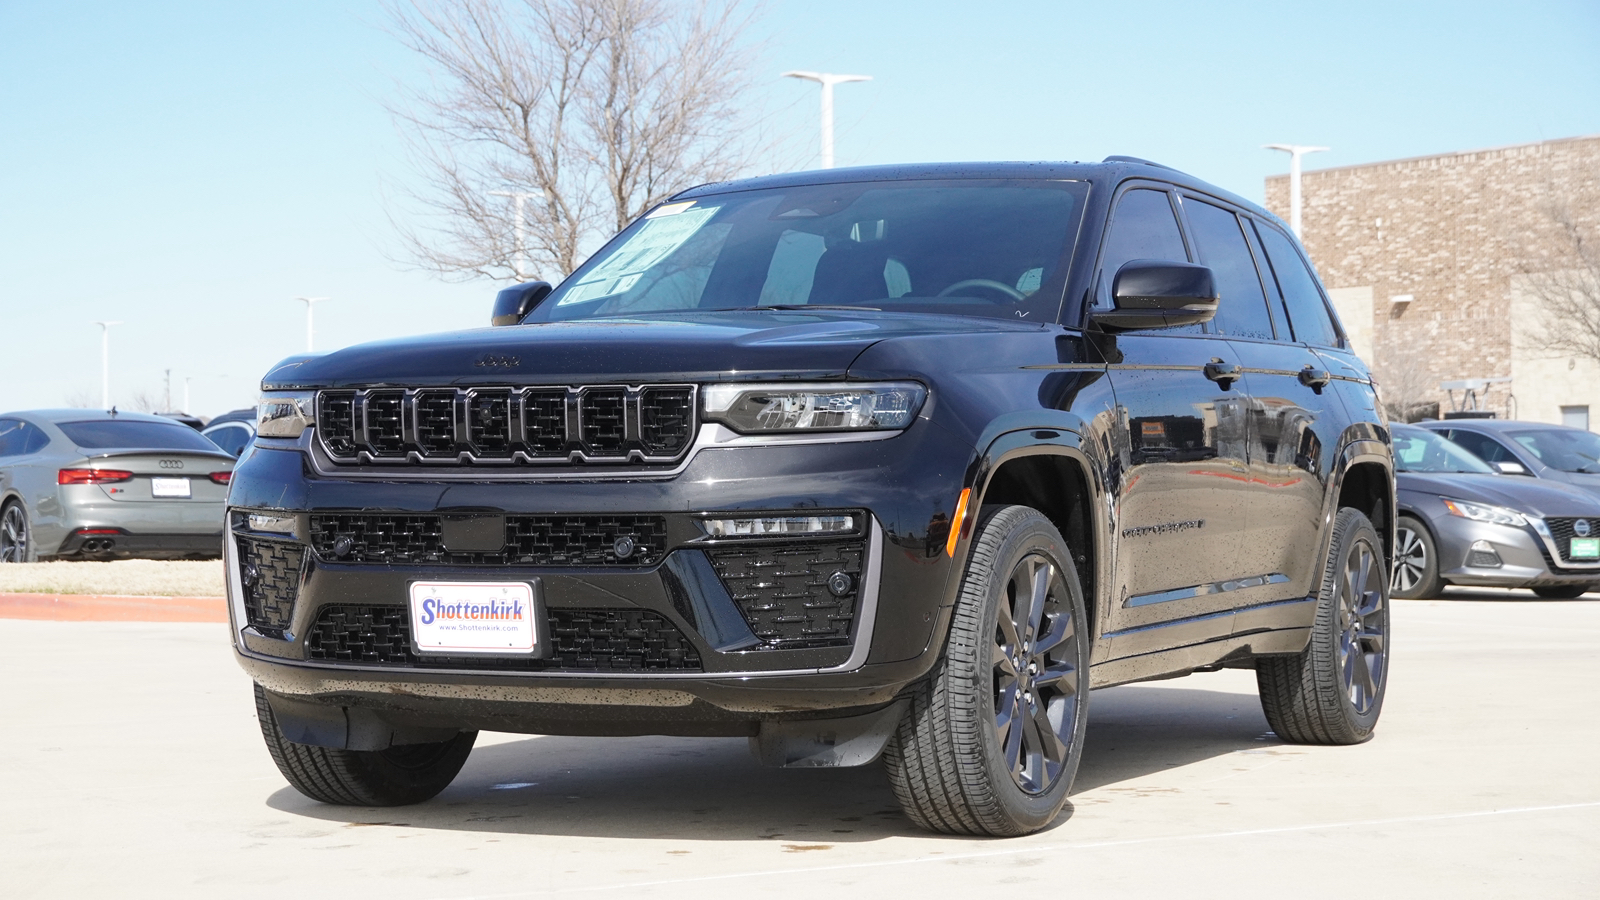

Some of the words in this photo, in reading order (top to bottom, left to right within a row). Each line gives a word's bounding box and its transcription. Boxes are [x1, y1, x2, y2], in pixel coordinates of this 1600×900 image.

[474, 353, 521, 369] Jeep
[421, 598, 523, 625] Shottenkirk
[439, 624, 519, 632] www.Shottenkirk.com
